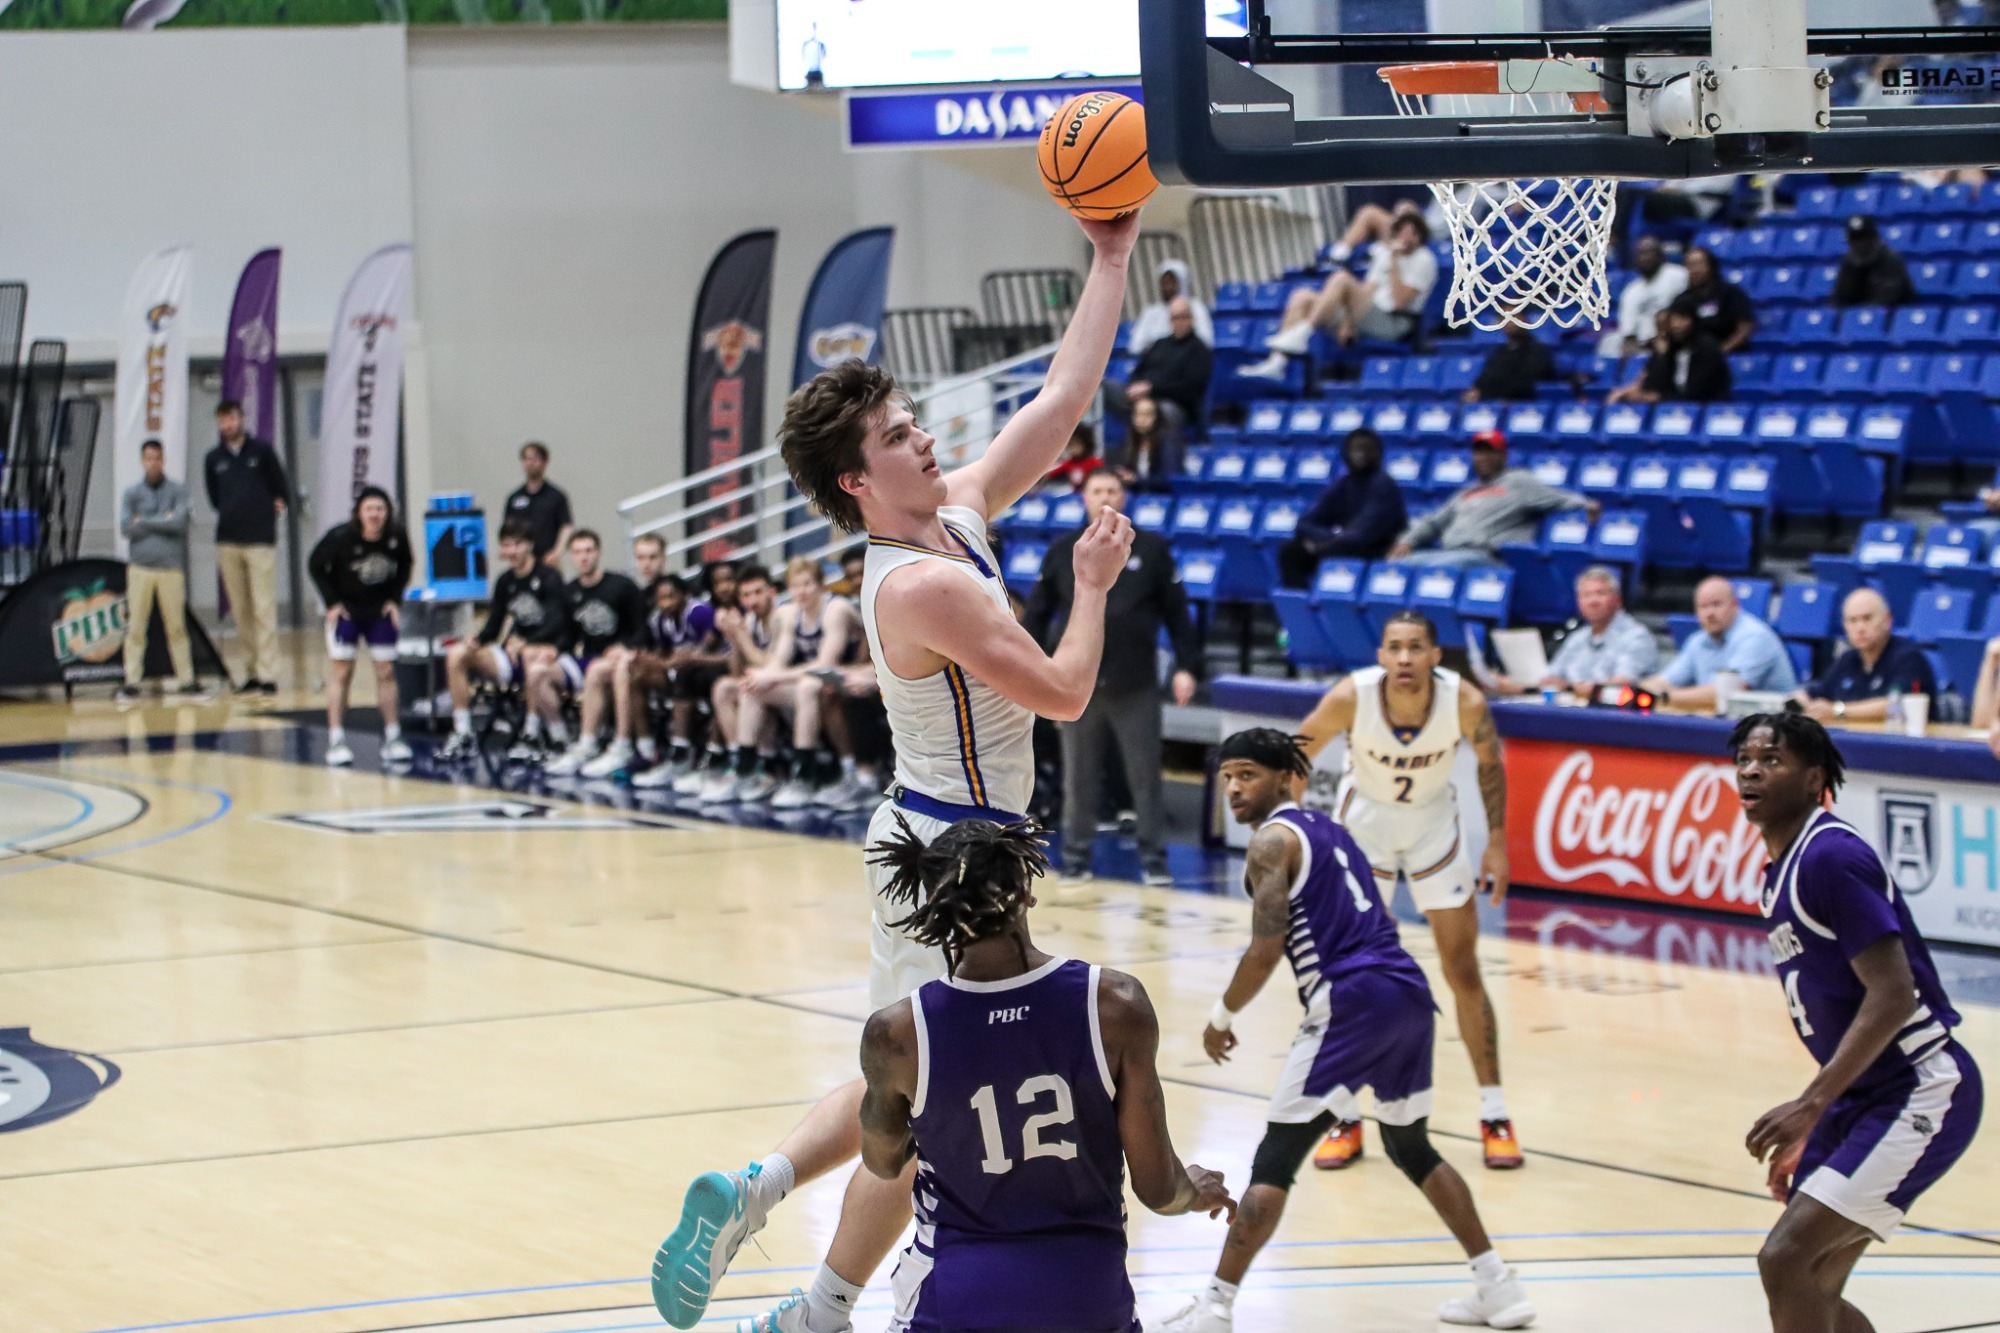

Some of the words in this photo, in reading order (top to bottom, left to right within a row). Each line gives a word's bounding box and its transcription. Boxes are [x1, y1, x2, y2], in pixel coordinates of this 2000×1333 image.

[935, 91, 1076, 139] DASAN
[1061, 92, 1122, 147] Wilson
[53, 597, 130, 664] PBC
[1393, 775, 1414, 803] 2
[1333, 846, 1373, 913] 1
[988, 1005, 1030, 1025] PBC
[1785, 970, 1815, 1037] 4
[970, 1073, 1078, 1175] 12
